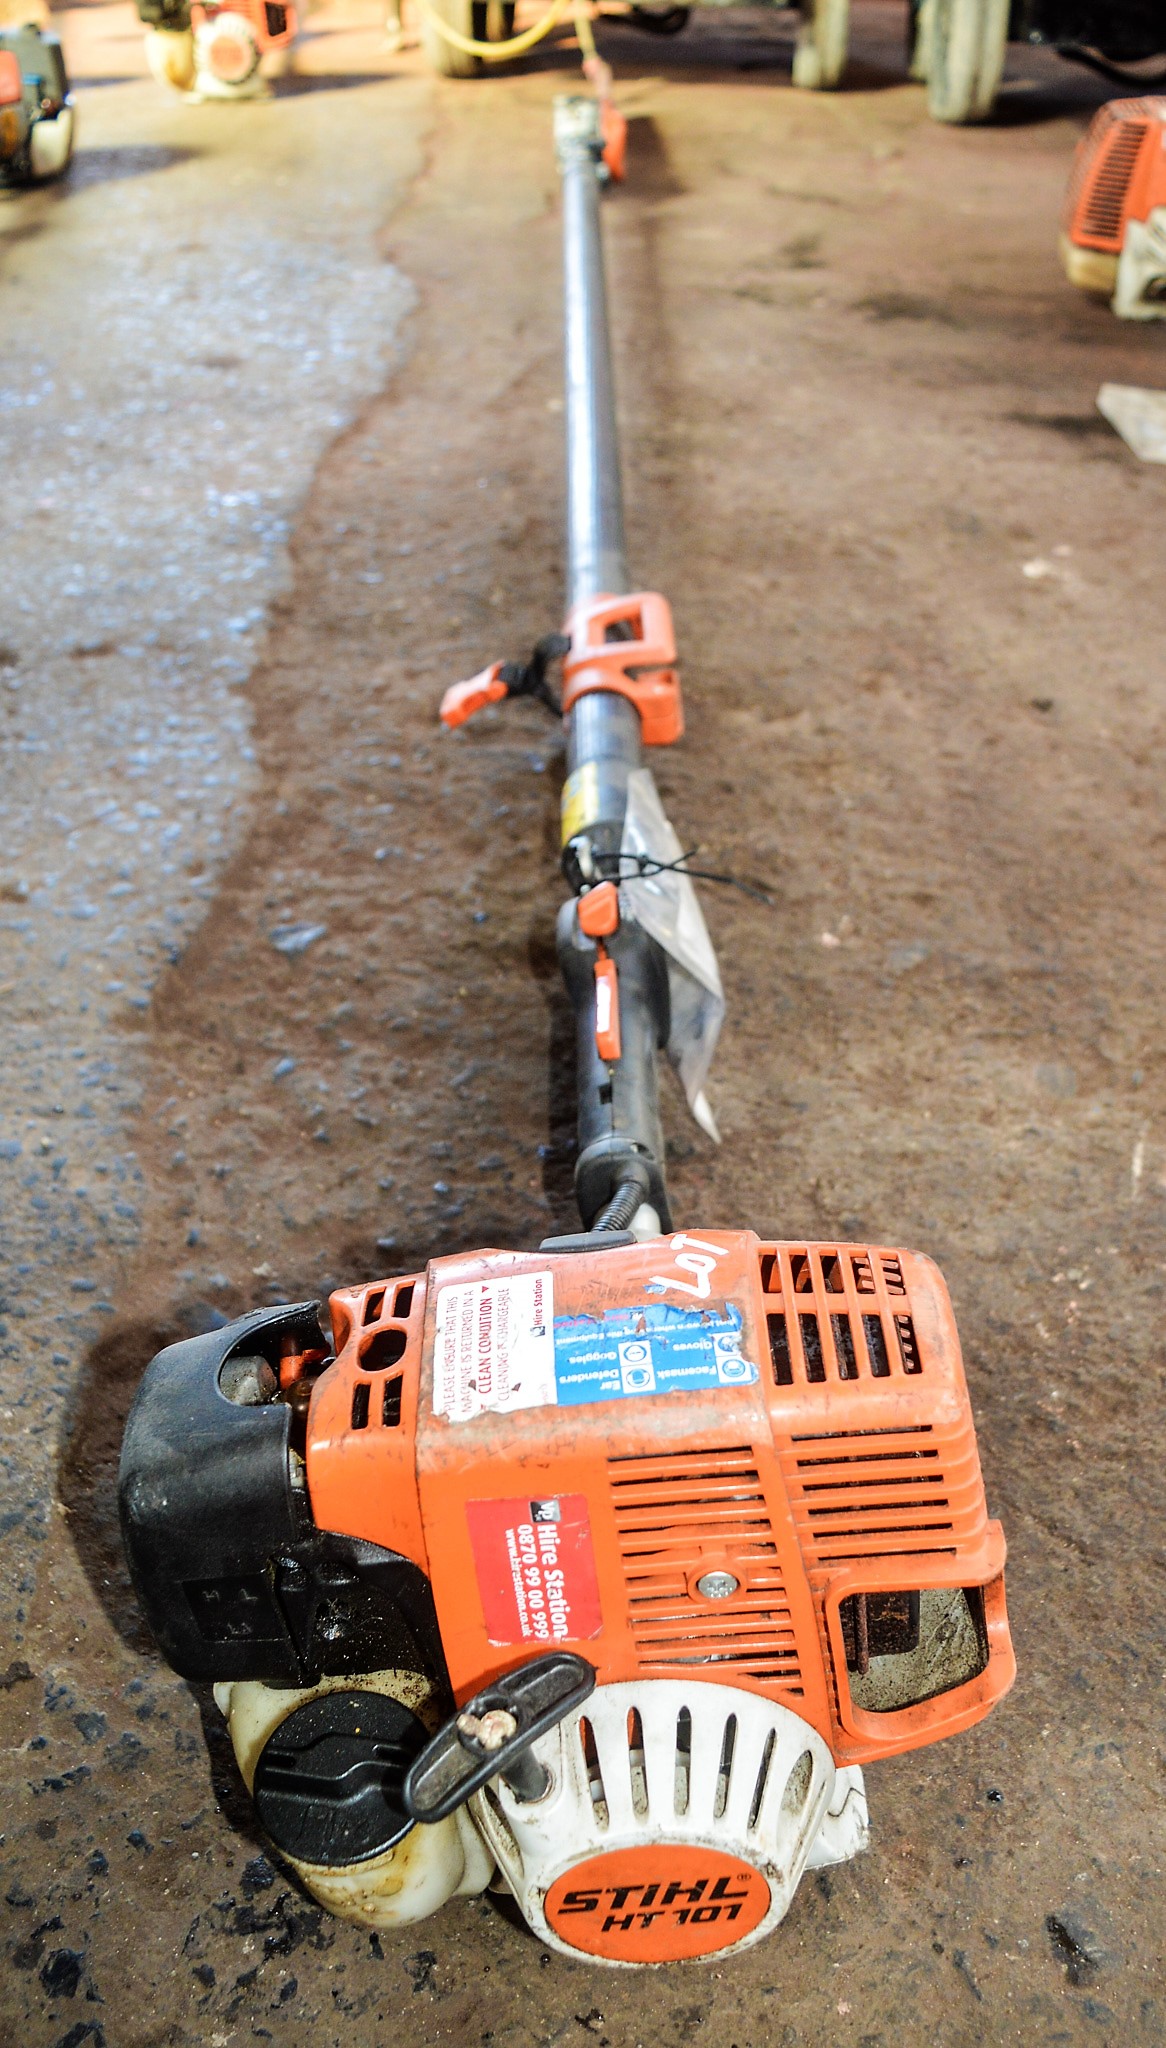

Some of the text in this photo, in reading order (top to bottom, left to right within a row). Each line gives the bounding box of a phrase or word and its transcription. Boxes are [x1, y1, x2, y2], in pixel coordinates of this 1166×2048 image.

[447, 1296, 458, 1313] THIS
[463, 1298, 474, 1308] IN
[533, 1279, 543, 1307] Station
[446, 1313, 457, 1336] THAT
[498, 1288, 510, 1339] CHARGEABLE
[534, 1307, 543, 1326] Hire
[461, 1310, 474, 1353] RETURNED
[478, 1298, 493, 1394] CLEAN CONDITION
[673, 1338, 714, 1351] Gloves
[461, 1354, 473, 1364] IS
[569, 1351, 617, 1364] Goggles
[497, 1351, 510, 1401] CLEANING
[560, 1368, 619, 1384] Defenders
[600, 1380, 621, 1391] Ear
[656, 1366, 717, 1380] Facemask
[444, 1375, 455, 1411] PLEASE
[518, 1524, 538, 1564] 0870
[505, 1528, 533, 1637] www.hirestation.co.uk
[524, 1567, 541, 1586] 99
[537, 1524, 570, 1638] Hire Station
[528, 1590, 544, 1608] 00
[532, 1611, 550, 1638] 999
[557, 1876, 749, 1915] STIHL
[601, 1903, 744, 1932] HT 101
